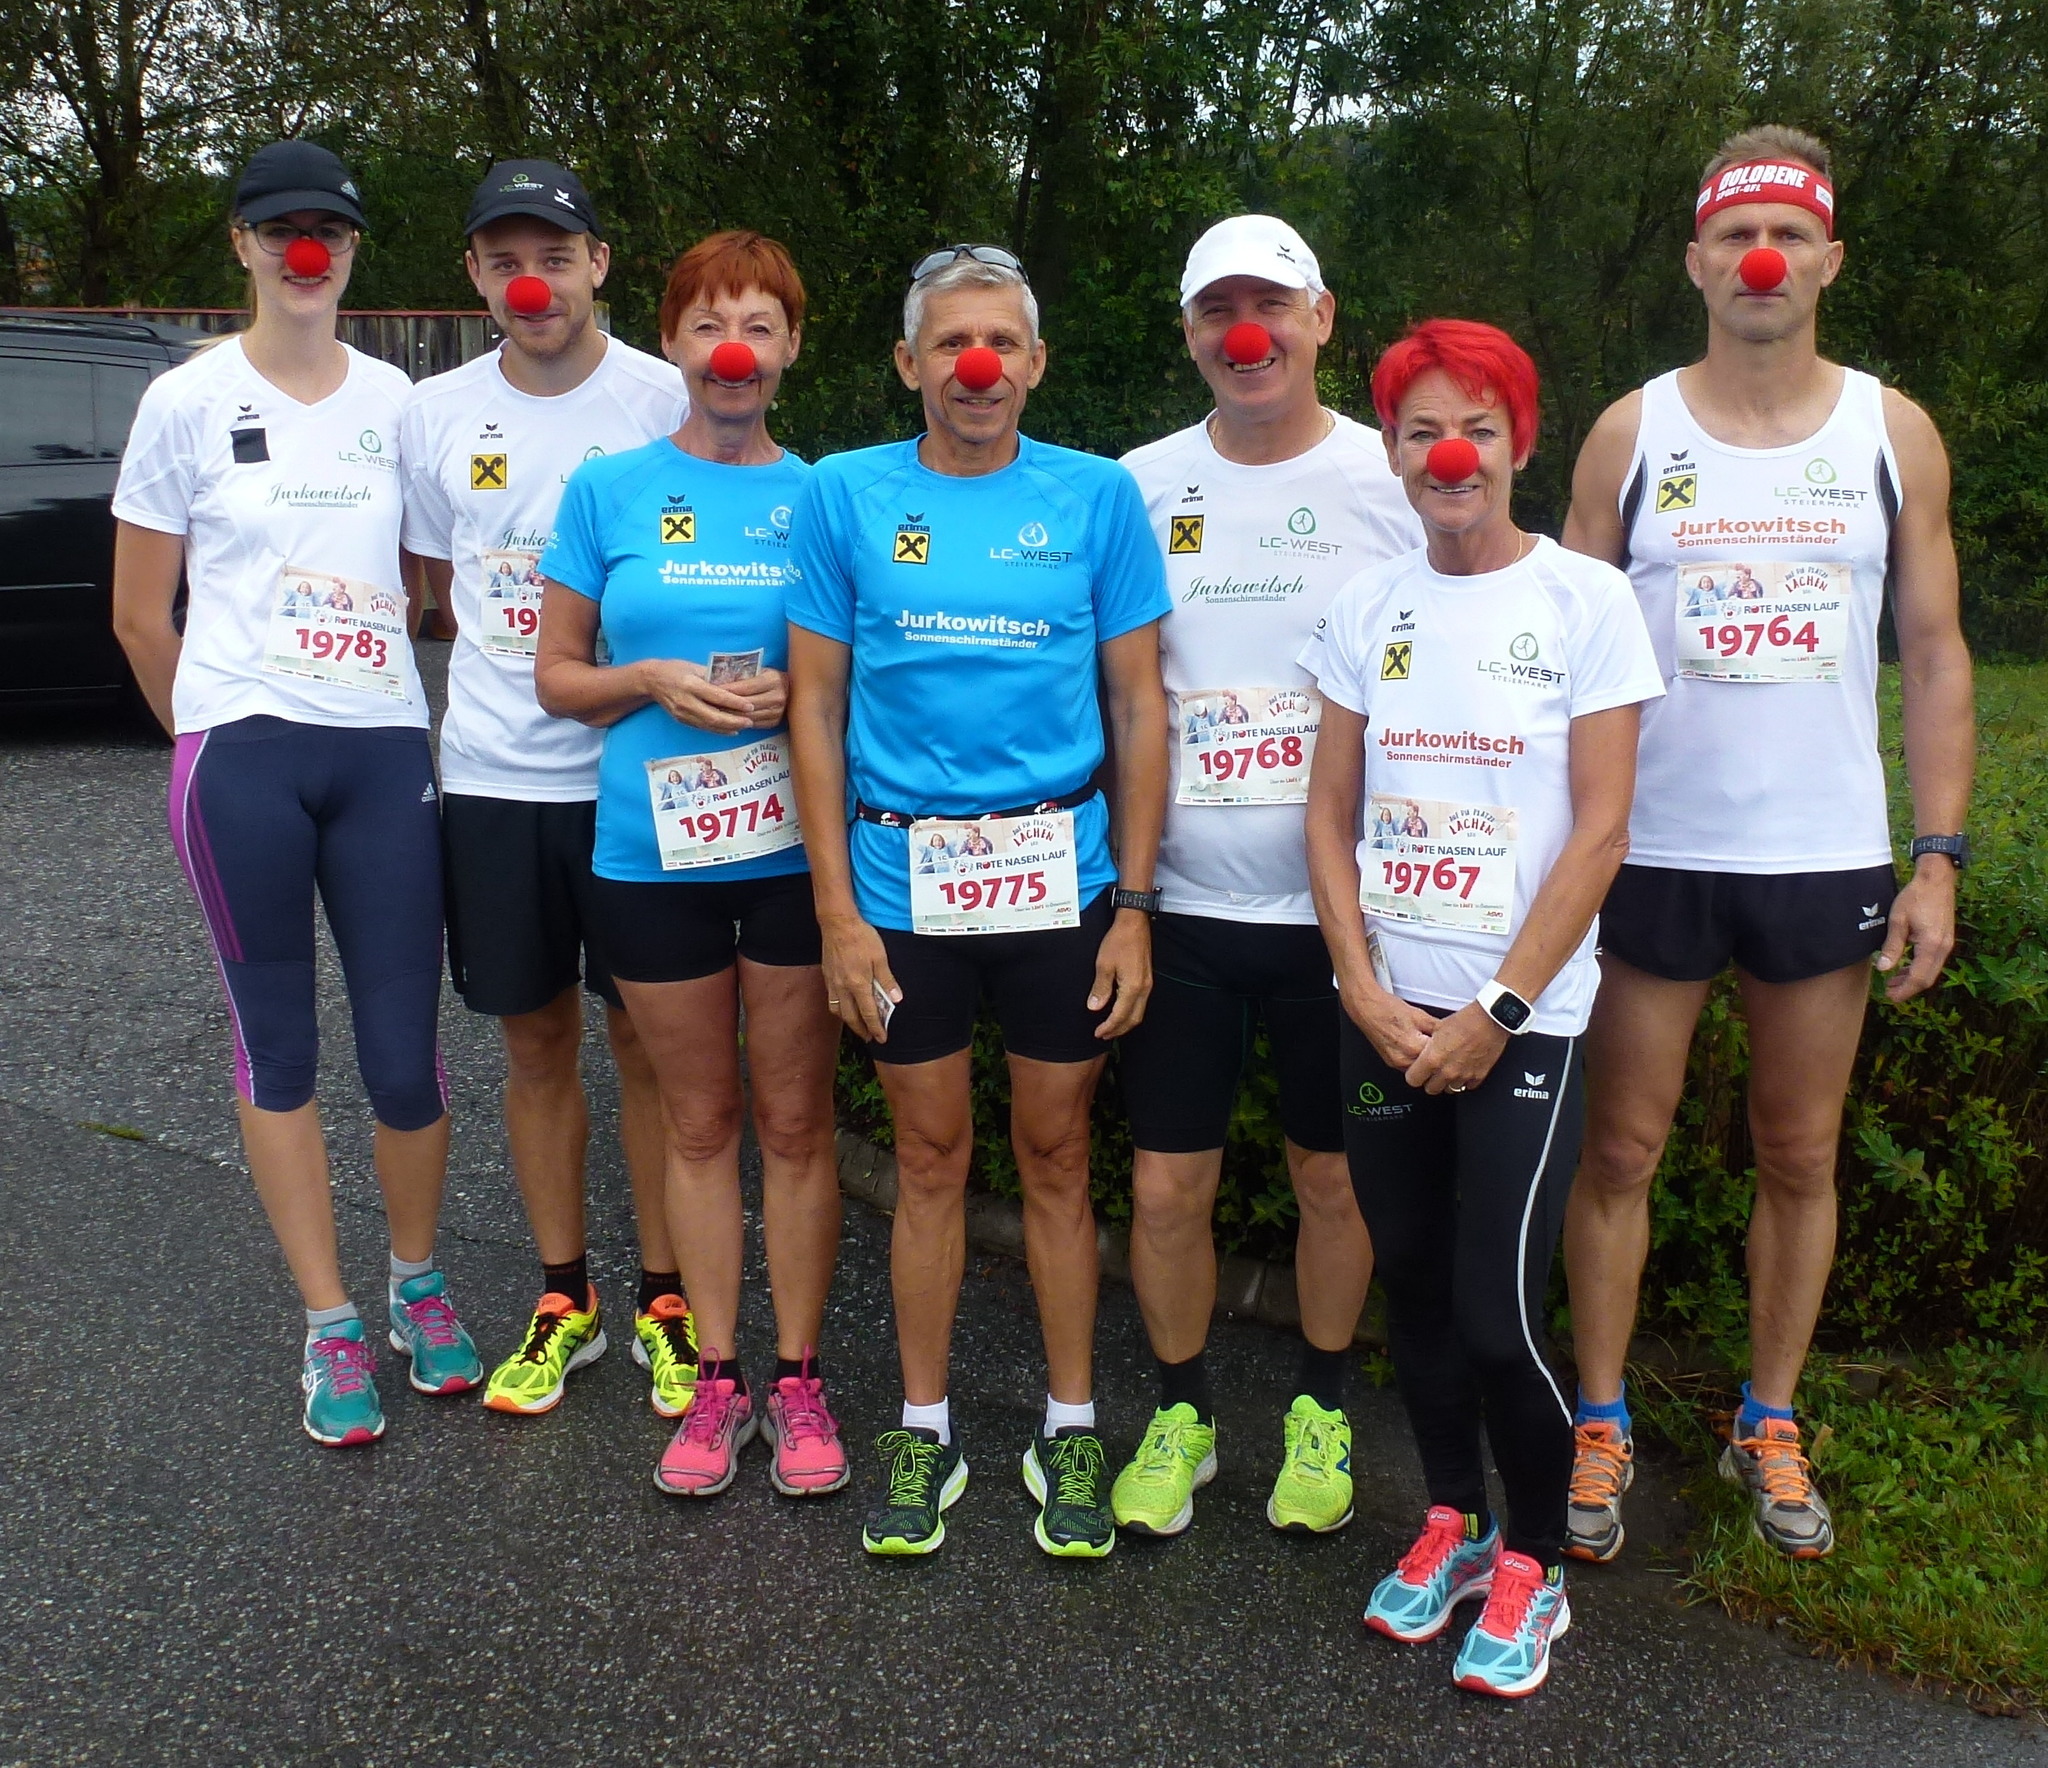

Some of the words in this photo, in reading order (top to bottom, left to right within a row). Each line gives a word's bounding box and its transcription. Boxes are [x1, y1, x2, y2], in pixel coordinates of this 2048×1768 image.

[1662, 461, 1697, 475] erima
[265, 482, 373, 505] Jurkowitsch
[1774, 486, 1868, 502] LC-WEST
[661, 504, 693, 514] erima
[897, 522, 931, 533] erima
[1671, 516, 1846, 538] Jurkowitsch
[1259, 536, 1343, 556] LC-WEST
[1677, 533, 1839, 549] Sonnenschirmständer
[989, 546, 1073, 563] LC-WEST
[1181, 574, 1308, 603] Jurkowitsch
[1744, 604, 1773, 615] ROTE
[1774, 602, 1811, 614] NASEN
[1812, 601, 1841, 612] LAUF
[359, 618, 386, 632] NASEN
[894, 608, 1051, 637] Jurkowitsch
[904, 631, 1039, 649] Sonnenschirmständer
[1698, 614, 1820, 658] 19764
[295, 627, 387, 668] 19783
[1477, 659, 1566, 684] LC-WEST
[1491, 674, 1549, 690] STEIERMARK
[1231, 727, 1258, 740] ROTE
[1260, 725, 1296, 737] NASEN
[1297, 723, 1319, 734] LAU
[1378, 727, 1526, 755] Jurkowitsch
[1198, 735, 1304, 782] 19768
[1386, 750, 1513, 769] Sonnenschirmständer
[712, 788, 739, 803] ROTE
[740, 778, 773, 796] NASEN
[678, 792, 785, 843] 19774
[1449, 817, 1495, 836] LACHEN
[1013, 827, 1055, 847] LACHEN
[1411, 843, 1436, 855] ROTE
[1437, 844, 1476, 857] NASEN
[1477, 846, 1508, 857] LAUF
[975, 858, 1003, 871] ROTE
[1004, 853, 1040, 868] NASEN
[1041, 849, 1068, 863] LAUF
[1382, 856, 1481, 900] 19767
[938, 871, 1047, 912] 19775
[1858, 916, 1886, 931] erima
[1513, 1087, 1550, 1100] erima
[1346, 1102, 1413, 1116] LC-WEST
